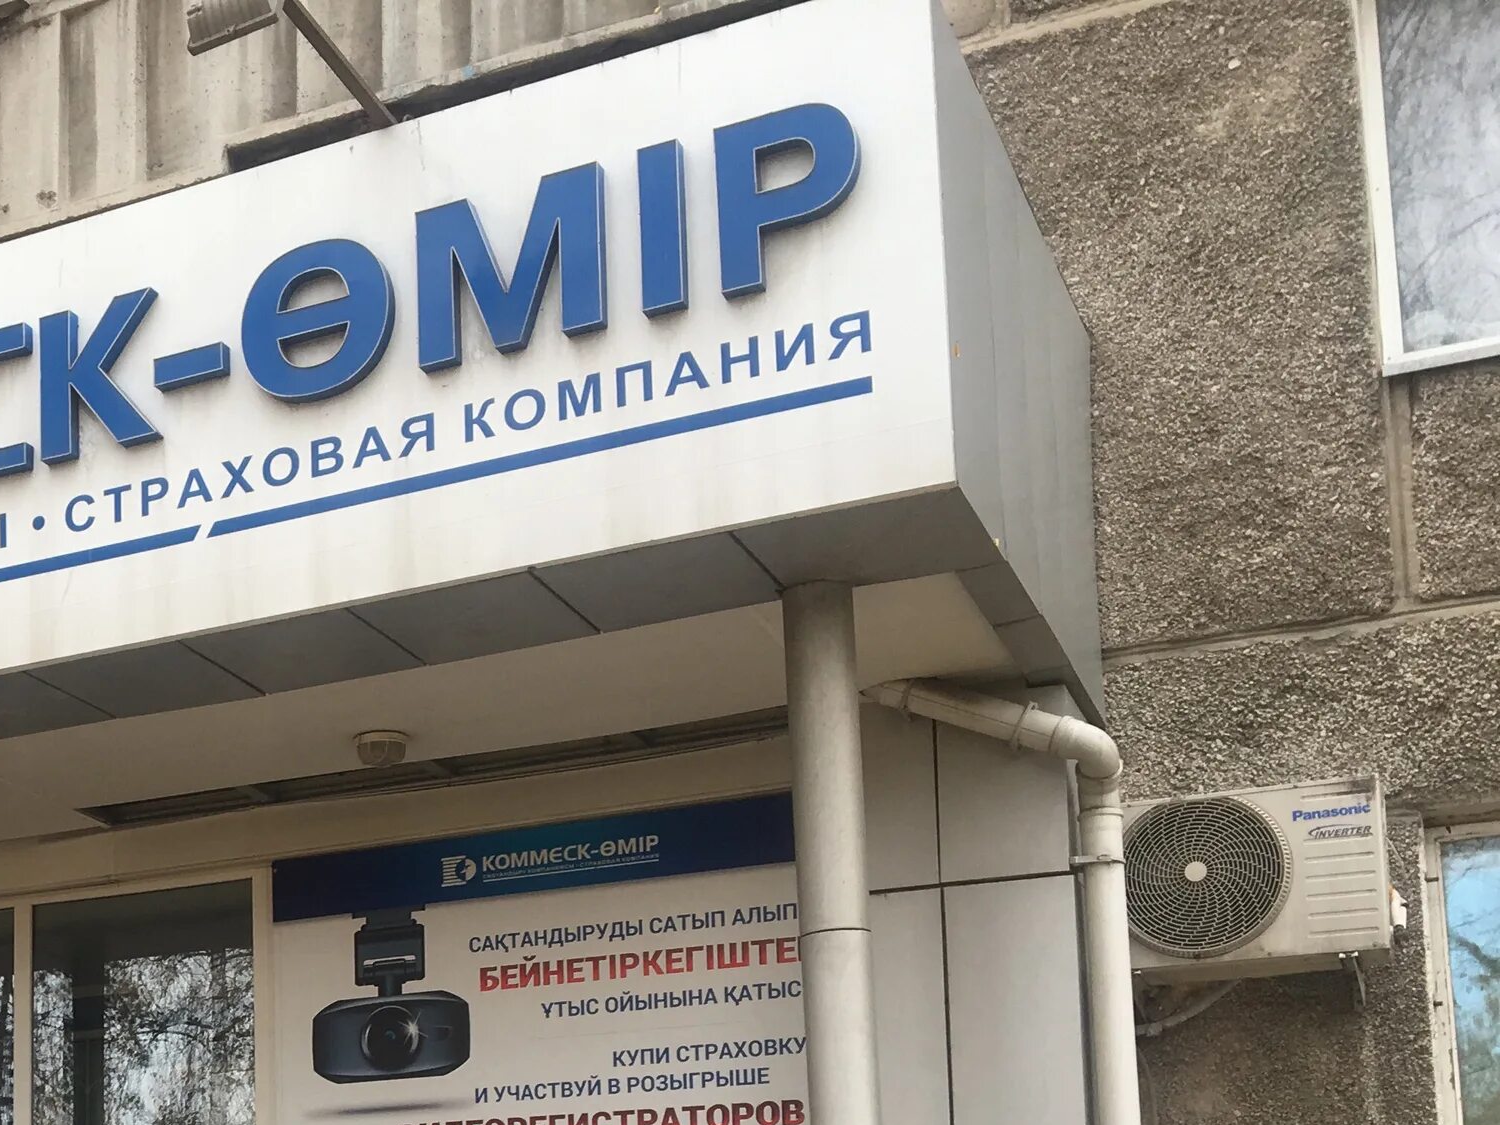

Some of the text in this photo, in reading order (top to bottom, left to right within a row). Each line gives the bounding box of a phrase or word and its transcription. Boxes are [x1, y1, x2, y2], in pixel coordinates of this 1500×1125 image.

[65, 412, 437, 532] СТРАХОВАЯ
[463, 310, 873, 443] КОМПАНИЯ
[1292, 803, 1371, 821] Panasonic
[1313, 826, 1372, 839] INVERTER
[469, 903, 797, 953] САҚТАНДЫРУДЫ САТЫП АЛЫП
[479, 937, 802, 991] БЕЙНЕТІРКЕГІШТЕ
[605, 988, 717, 1013] ОЙЫНЫНА
[612, 1037, 807, 1068] КУПИ СТРАХОВКУ
[475, 1067, 770, 1103] И УЧАСТВУЙ В РОЗЫГРЫШЕ
